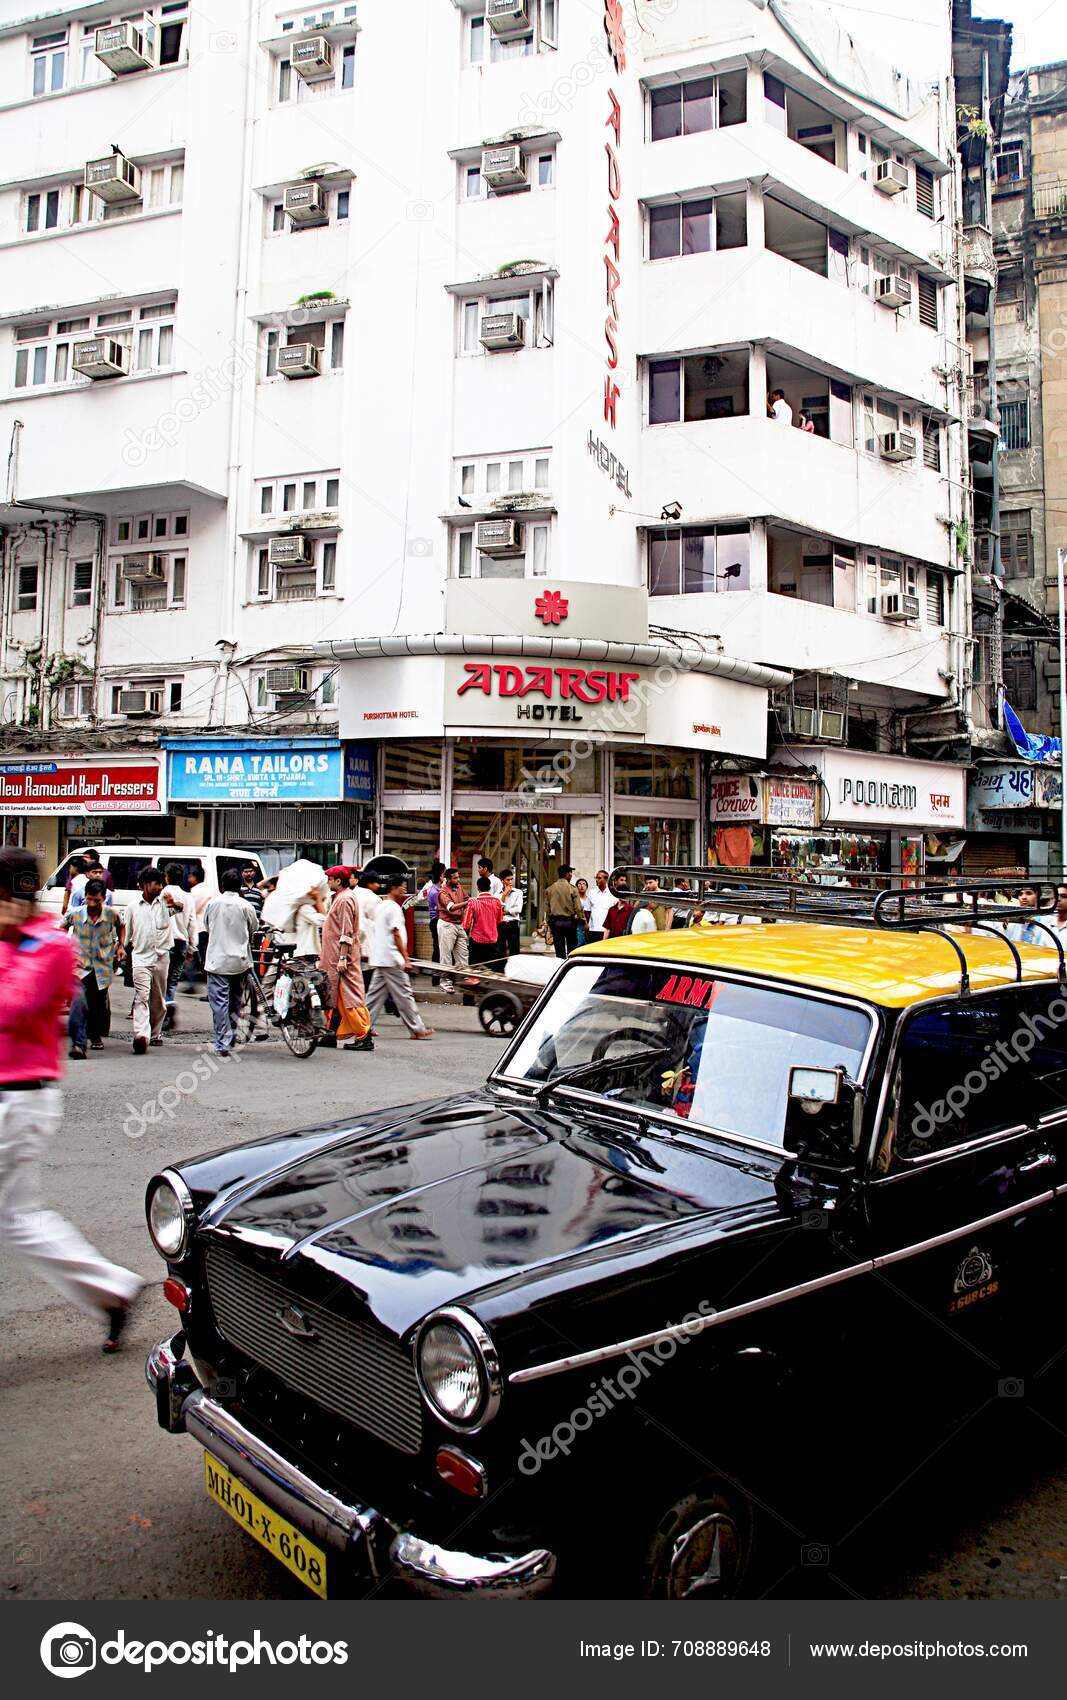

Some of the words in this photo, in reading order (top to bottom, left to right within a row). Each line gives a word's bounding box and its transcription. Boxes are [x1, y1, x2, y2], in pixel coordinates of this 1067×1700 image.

[603, 87, 621, 431] ADARSH
[586, 428, 633, 501] HOTEL
[457, 663, 640, 704] ADARSH
[363, 711, 398, 721] PURSHOTTAM
[399, 710, 419, 719] HOTEL
[517, 704, 583, 722] HOTEL
[185, 757, 245, 774] RANA
[251, 754, 329, 773] TAILORS
[350, 757, 369, 772] RANA
[25, 775, 78, 796] Ramwadi
[79, 775, 100, 796] Hair
[101, 774, 154, 796] Dressers
[347, 774, 371, 790] TAILORS
[711, 779, 740, 801] CHOICE
[91, 800, 114, 809] Gents
[116, 800, 152, 809] Parlour
[716, 797, 758, 813] Corner
[929, 793, 951, 811] पूनम
[656, 974, 726, 1009] ARMY
